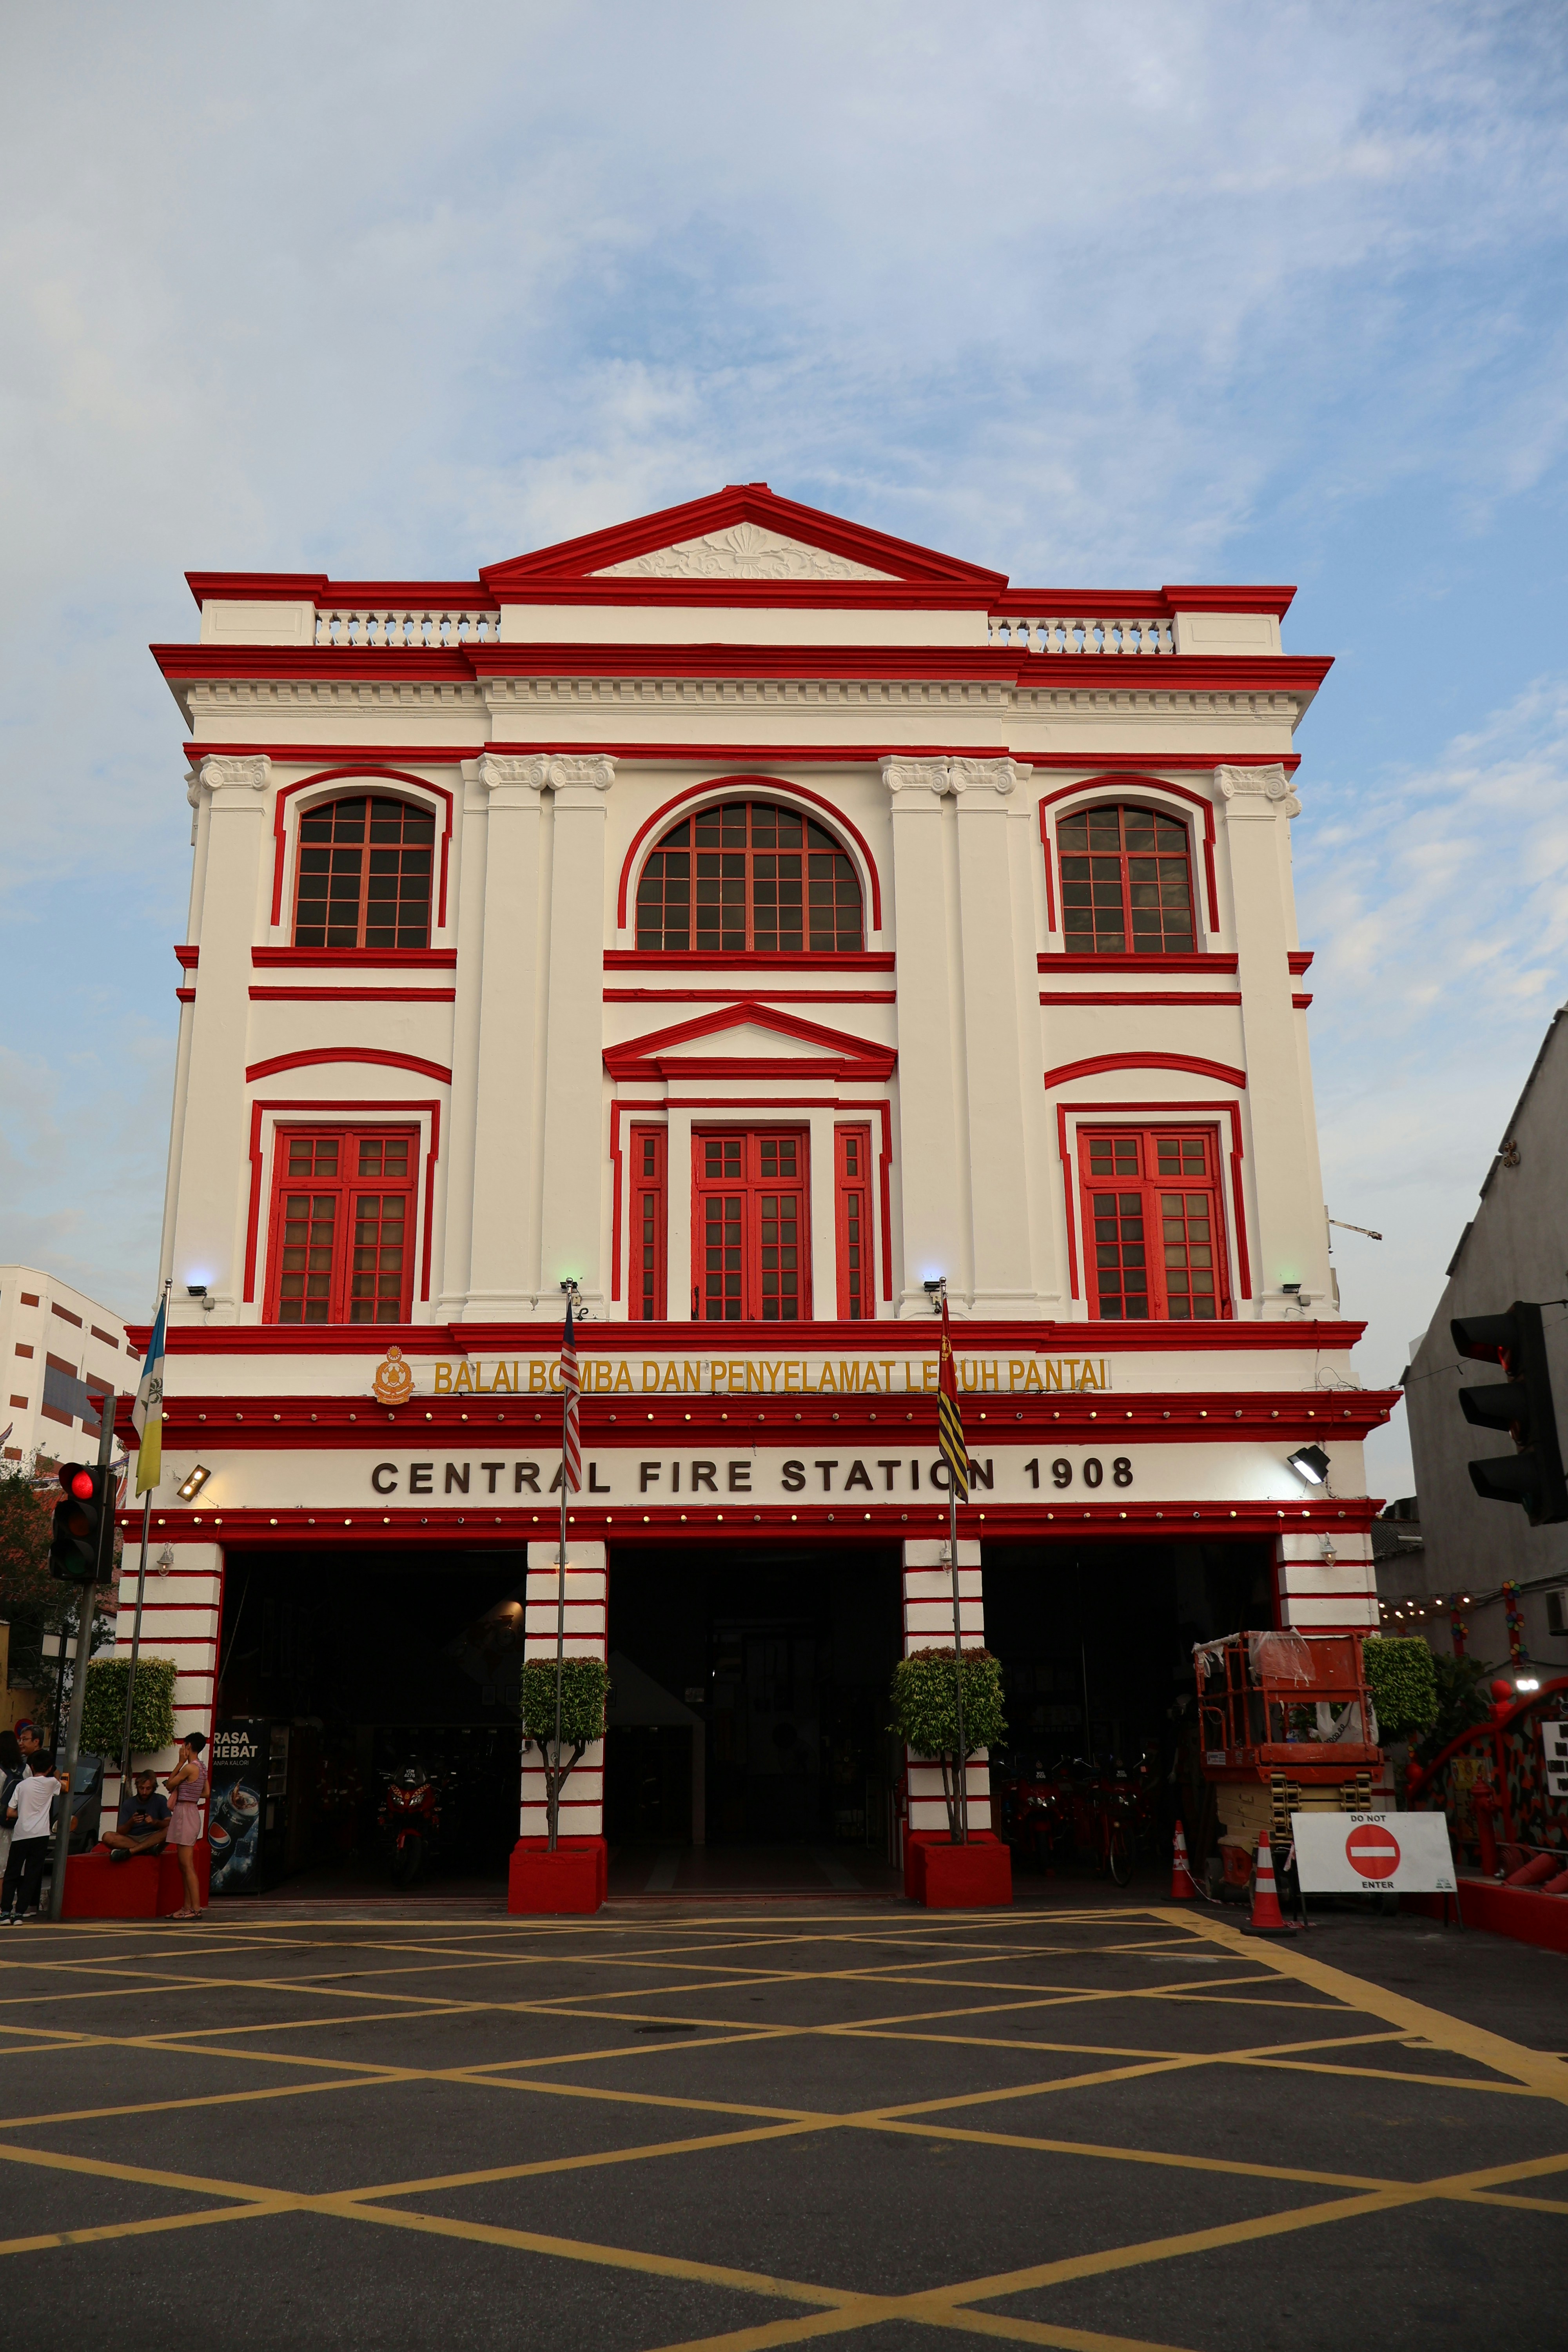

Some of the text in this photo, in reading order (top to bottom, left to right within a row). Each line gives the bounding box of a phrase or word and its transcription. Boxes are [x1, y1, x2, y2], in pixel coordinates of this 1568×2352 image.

[434, 1359, 1105, 1394] BALAI BOMBA DAN PENYELAMAT LEUH PANTAI
[640, 1461, 752, 1492] FIRE
[1025, 1457, 1133, 1488] 1908
[214, 1732, 249, 1744] RASA
[212, 1746, 258, 1758] HEBAT
